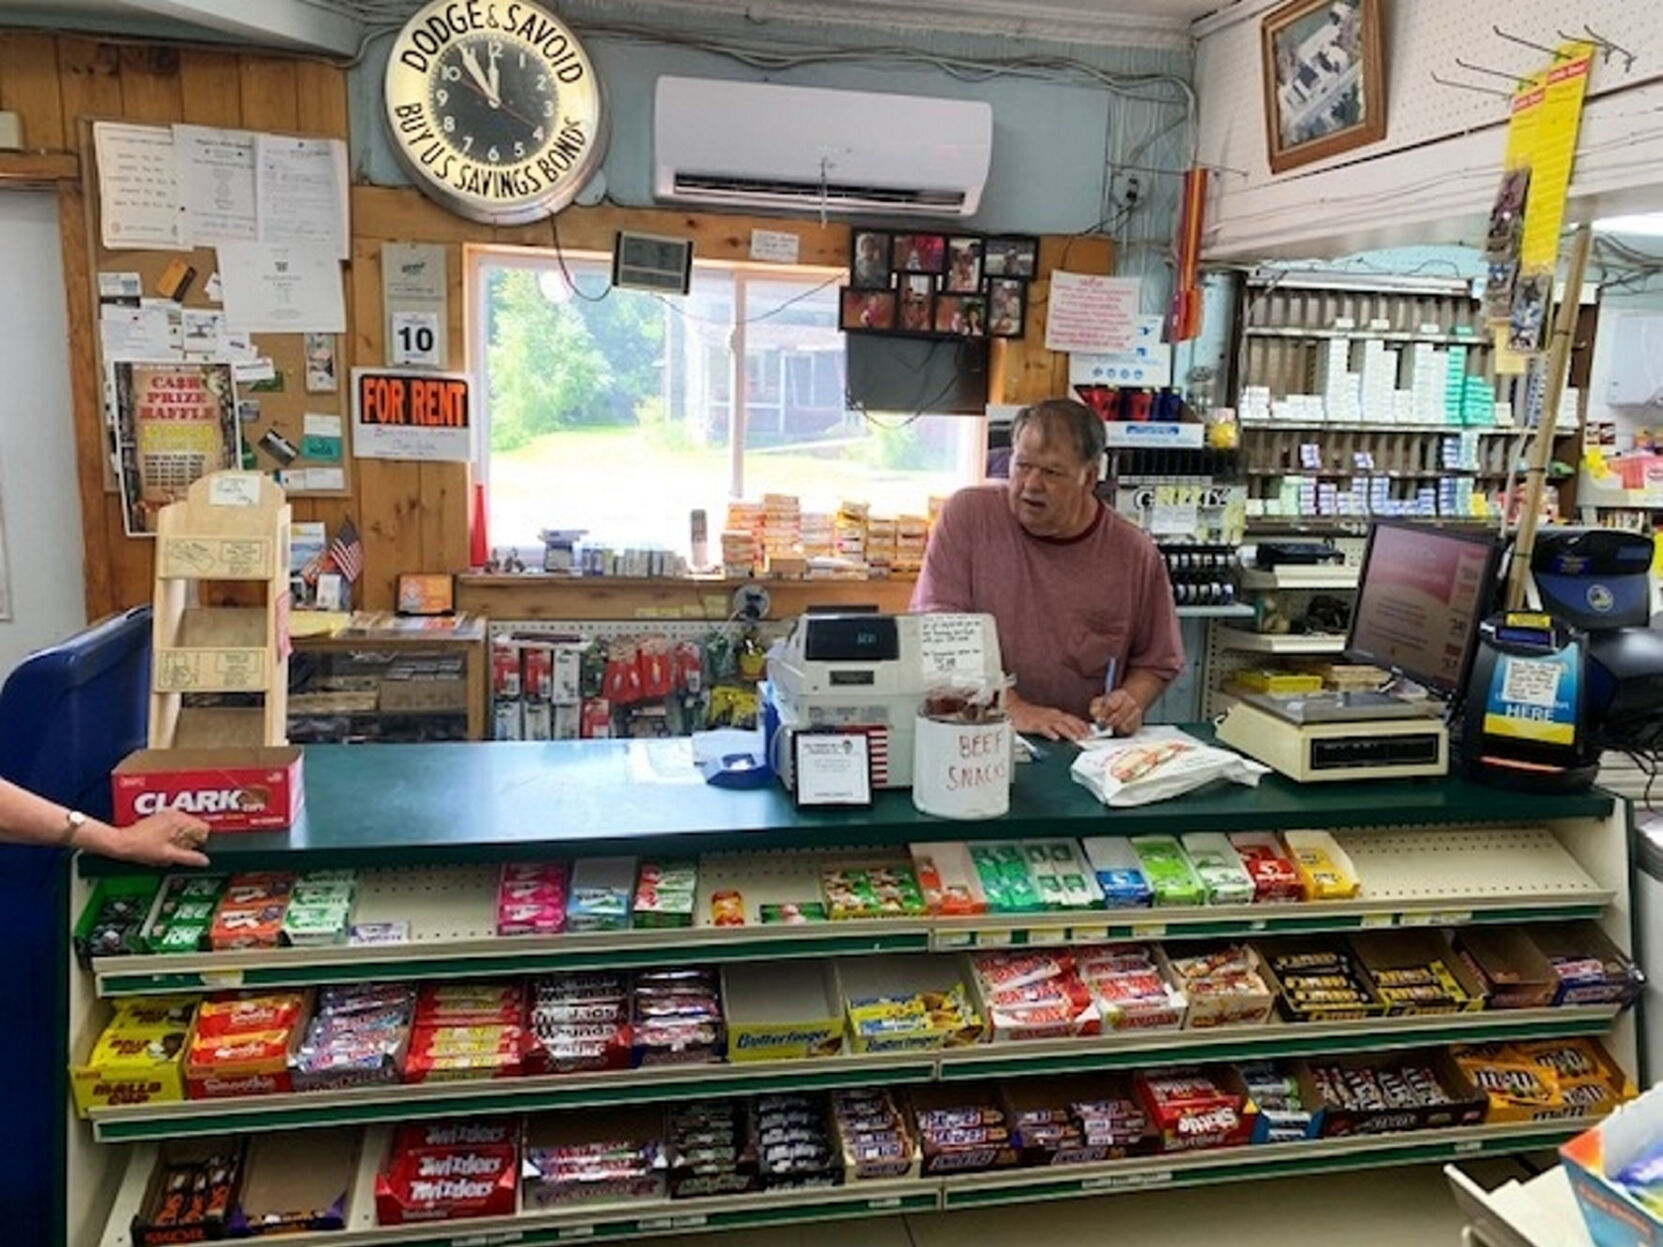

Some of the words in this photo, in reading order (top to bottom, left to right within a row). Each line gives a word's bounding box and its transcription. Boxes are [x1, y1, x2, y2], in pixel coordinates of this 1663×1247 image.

[401, 0, 484, 73] DODGE
[486, 4, 500, 29] &
[537, 74, 547, 91] 2
[436, 90, 449, 107] 9
[444, 115, 455, 132] 8
[395, 102, 434, 146] BUY
[453, 163, 542, 199] SAVINGS
[488, 145, 500, 162] 6
[513, 142, 525, 157] 5
[398, 326, 434, 352] 10
[363, 377, 404, 424] FOR
[410, 380, 466, 428] RENT
[1505, 703, 1555, 724] HERE
[958, 732, 1004, 760] BEEF
[134, 789, 243, 815] CLARK
